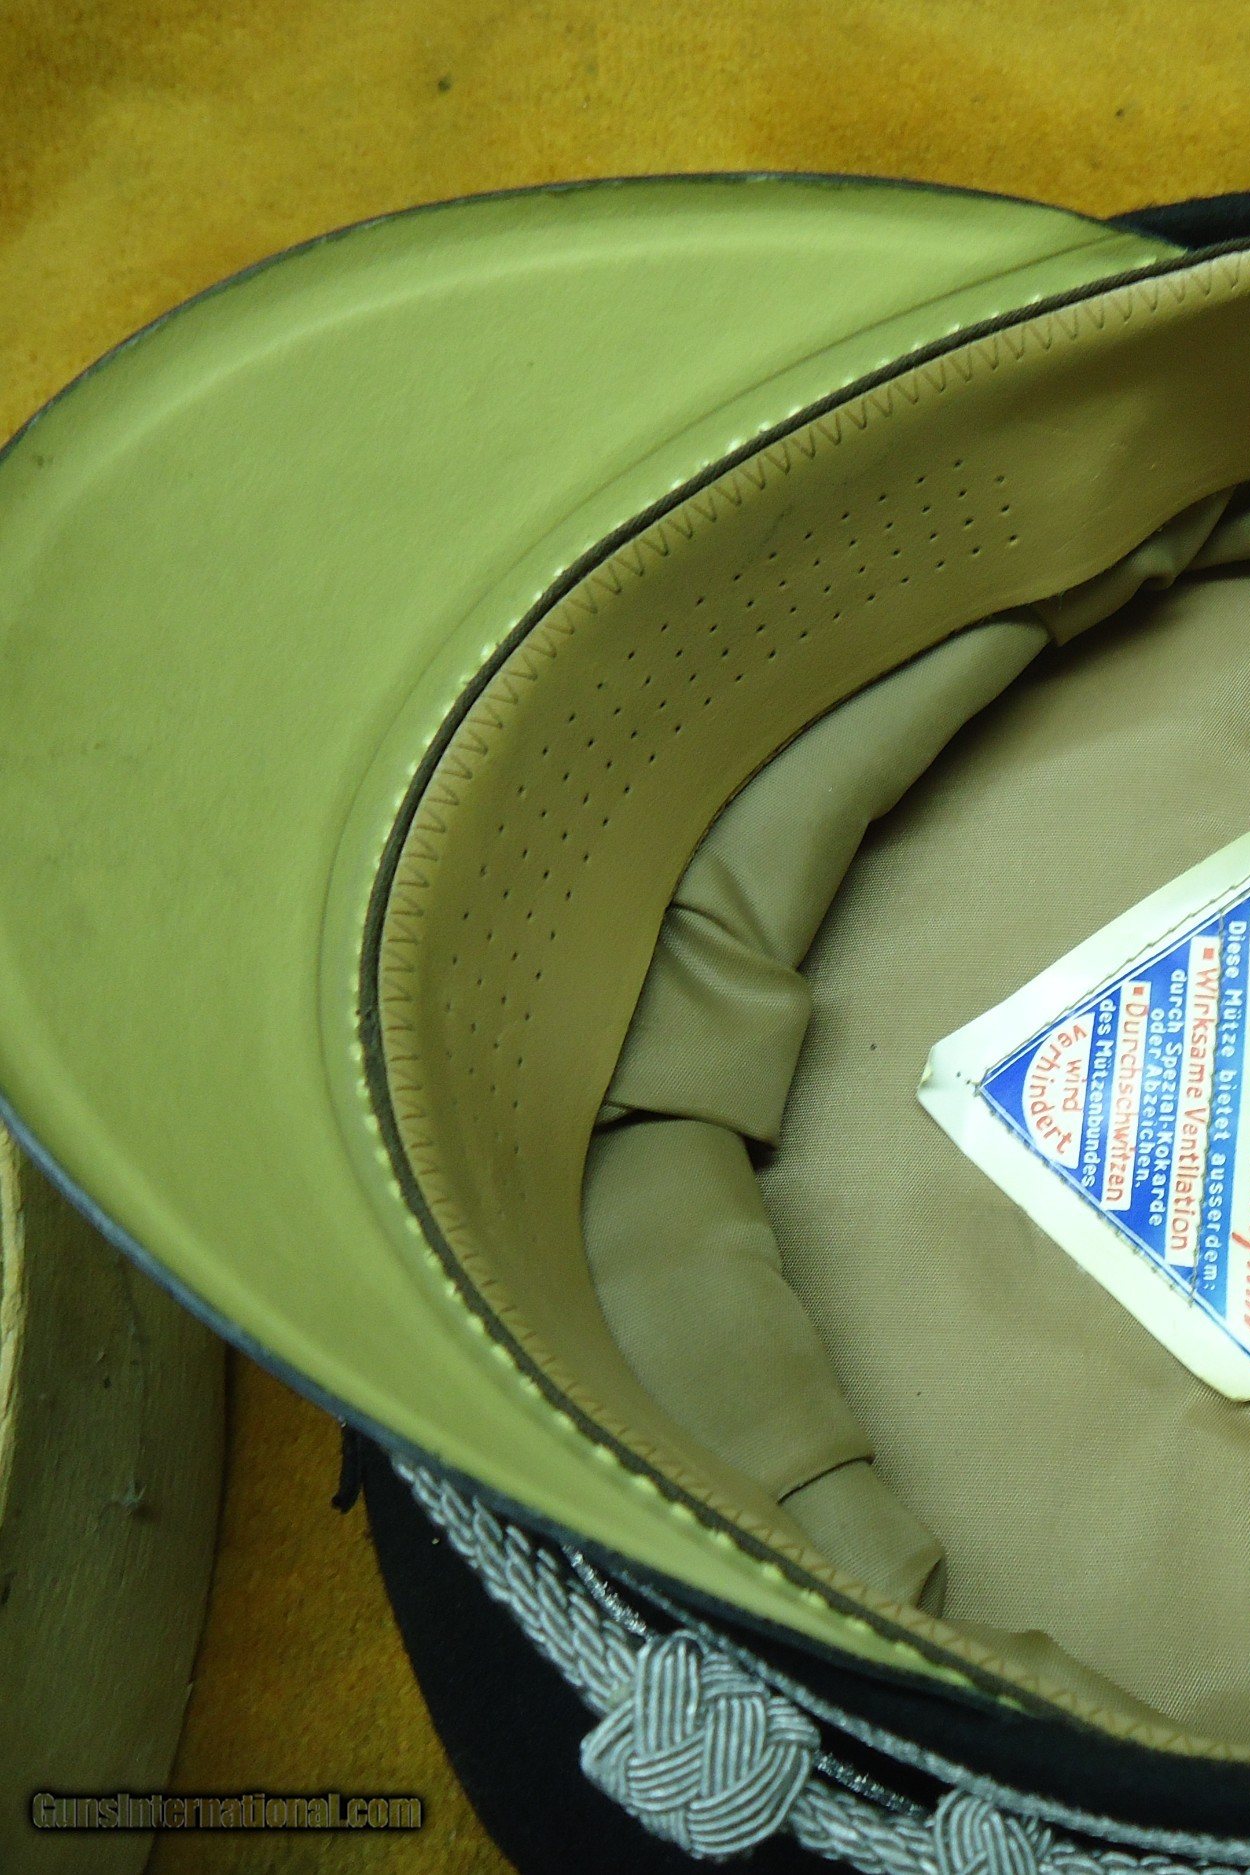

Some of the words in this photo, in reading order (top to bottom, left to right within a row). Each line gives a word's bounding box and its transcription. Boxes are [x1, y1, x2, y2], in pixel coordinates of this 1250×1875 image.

[1167, 968, 1188, 1033] durch
[1224, 920, 1247, 979] Diese
[1097, 998, 1116, 1035] des
[1148, 1008, 1166, 1060] oder
[1186, 967, 1218, 1098] Wirksame
[1221, 989, 1243, 1057] Mütze
[1029, 1025, 1087, 1154] verhindert
[1062, 1059, 1088, 1112] wird
[1080, 1040, 1115, 1188] Mützenbundes
[1105, 1003, 1149, 1202] Durchschwitzen
[1135, 1064, 1158, 1188] Abzeichen.
[1149, 1042, 1182, 1227] Spezial-Kokarde
[1213, 1069, 1237, 1140] bietet
[1170, 1108, 1206, 1252] Ventilation
[1203, 1153, 1227, 1291] ausserdem:
